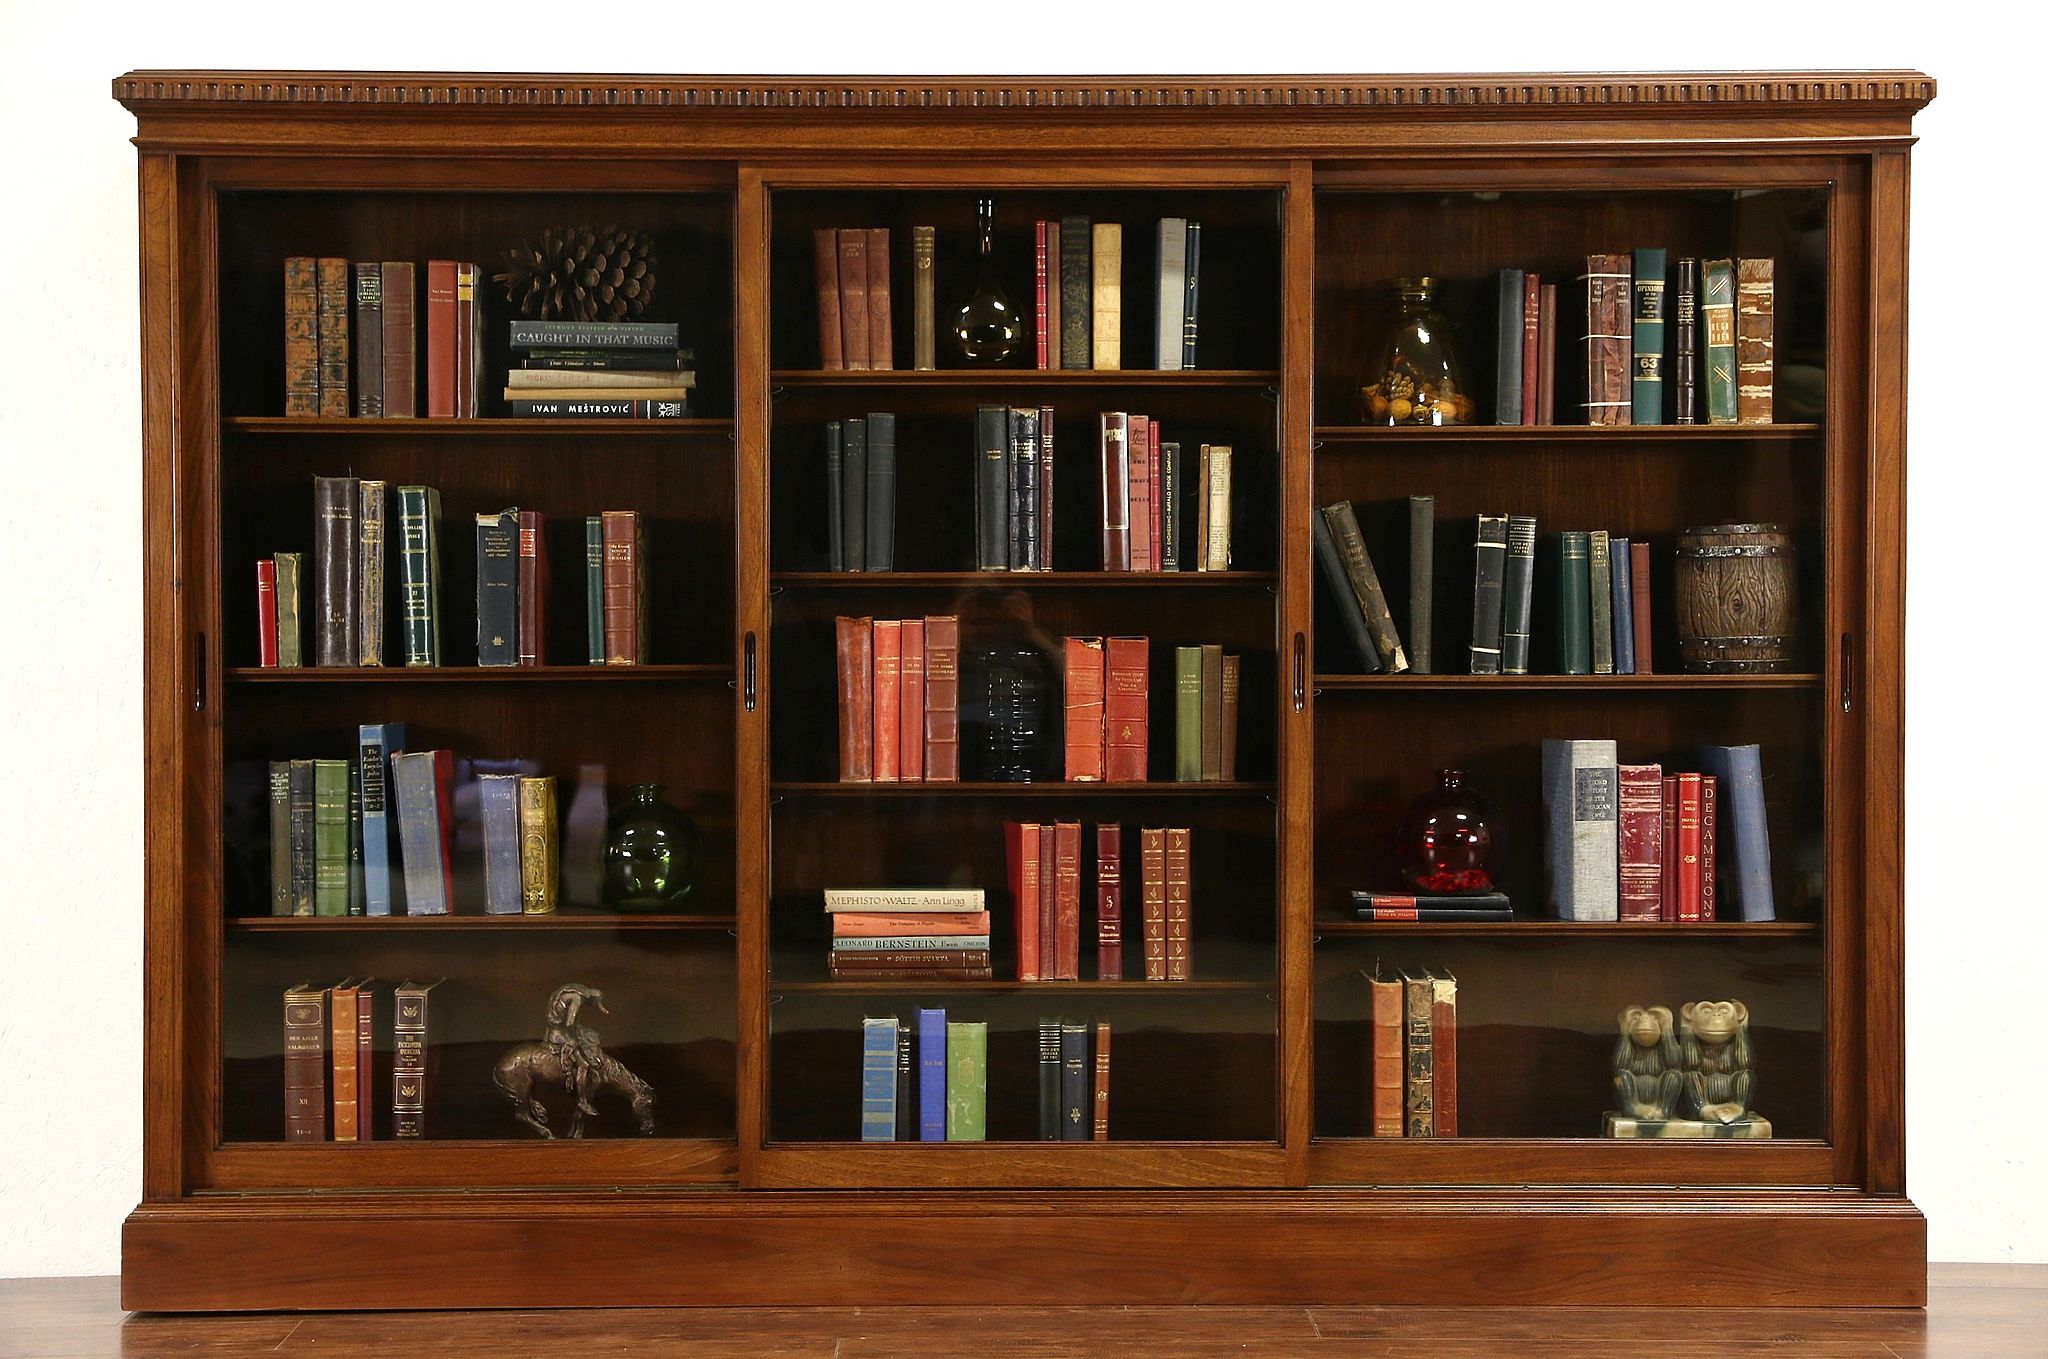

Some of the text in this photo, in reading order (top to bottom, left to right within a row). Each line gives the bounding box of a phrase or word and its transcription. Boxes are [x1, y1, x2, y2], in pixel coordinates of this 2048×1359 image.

[516, 333, 673, 346] CAUGHT IN THAT MUSIC
[1640, 358, 1658, 369] 63
[532, 403, 630, 414] IVAN MEŠTROVIĆ
[1703, 789, 1714, 910] DECAMERON
[831, 896, 965, 906] MEPHISTO WALTZ Ann Lingg
[874, 940, 936, 948] BERNSTEIN
